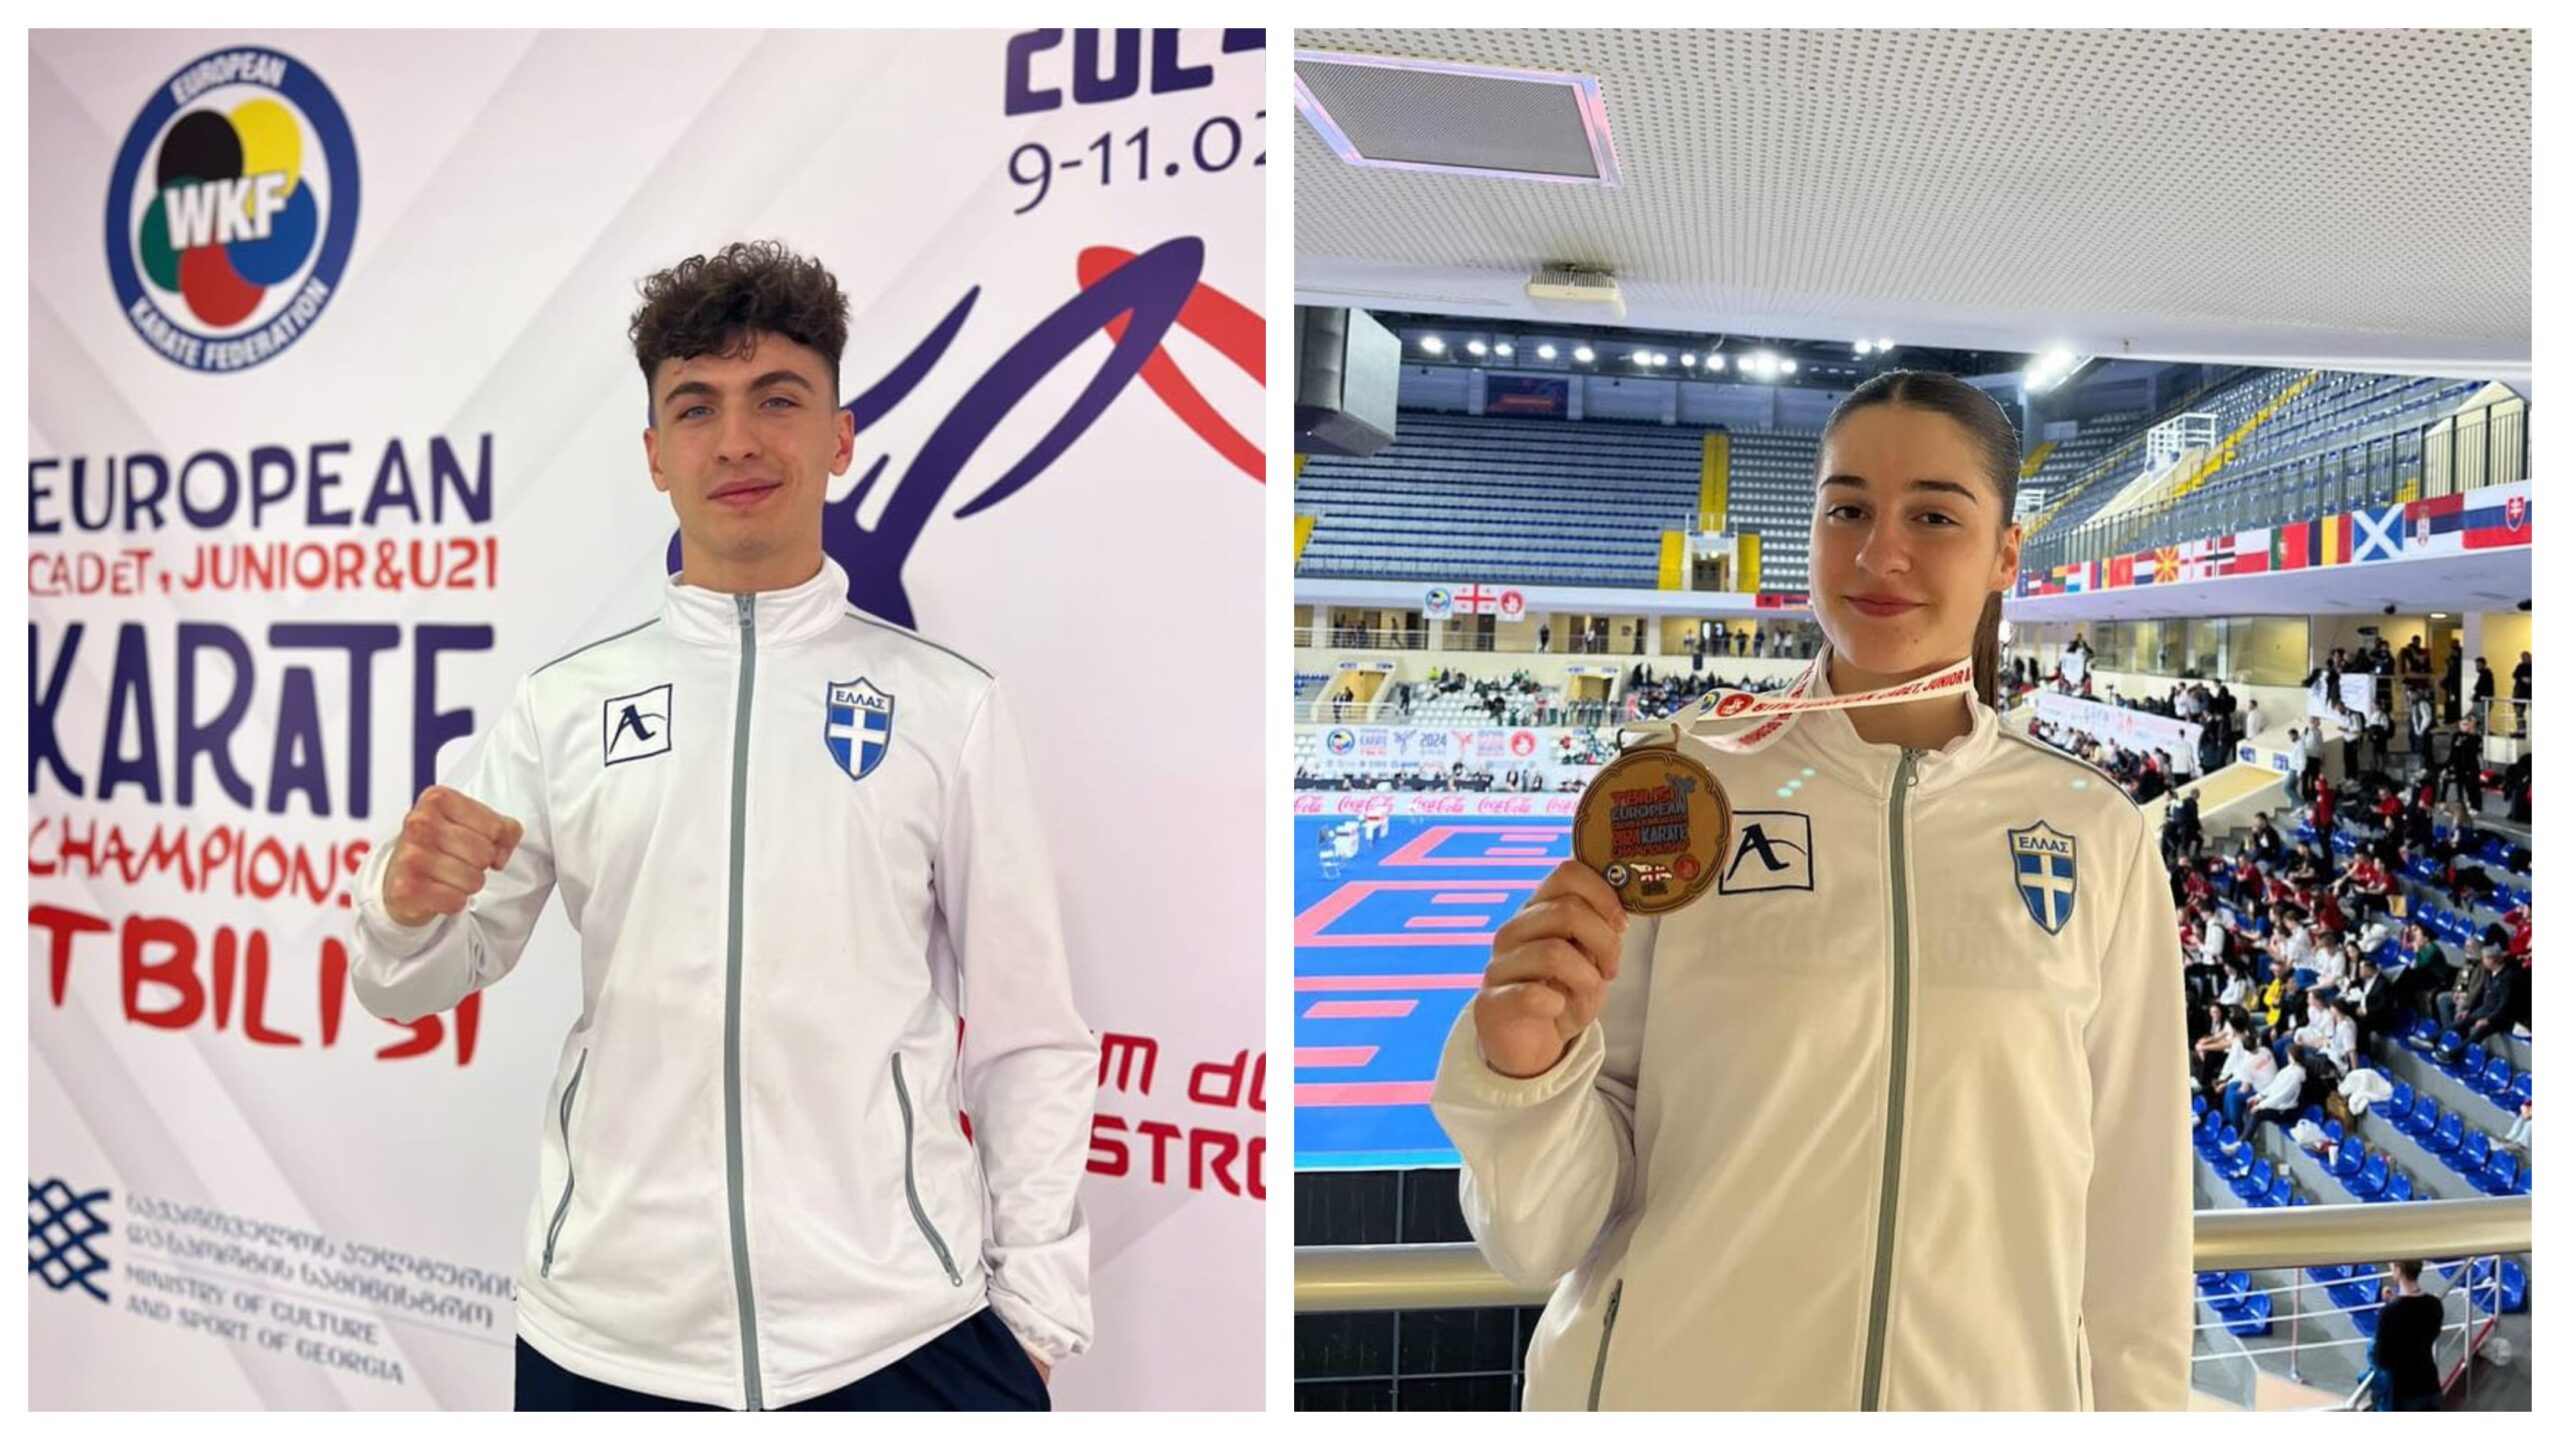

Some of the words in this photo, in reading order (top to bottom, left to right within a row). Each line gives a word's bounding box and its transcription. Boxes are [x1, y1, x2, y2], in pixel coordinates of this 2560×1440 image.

[171, 51, 288, 106] EUROPEAN
[1004, 28, 1266, 117] 202
[163, 170, 287, 251] WKF
[128, 296, 204, 368] KARATE
[203, 275, 331, 371] FEDERATION
[28, 432, 493, 536] EUROPEAN
[1419, 732, 1447, 748] 2024
[1641, 823, 1687, 844] KARATE
[124, 1262, 225, 1306] MINISTRY
[233, 1290, 263, 1315] OF
[269, 1300, 381, 1346] CULTURE
[124, 1294, 172, 1322] AND
[178, 1306, 249, 1343] SPORT
[256, 1328, 290, 1353] OF
[294, 1336, 405, 1385] GEORGIA
